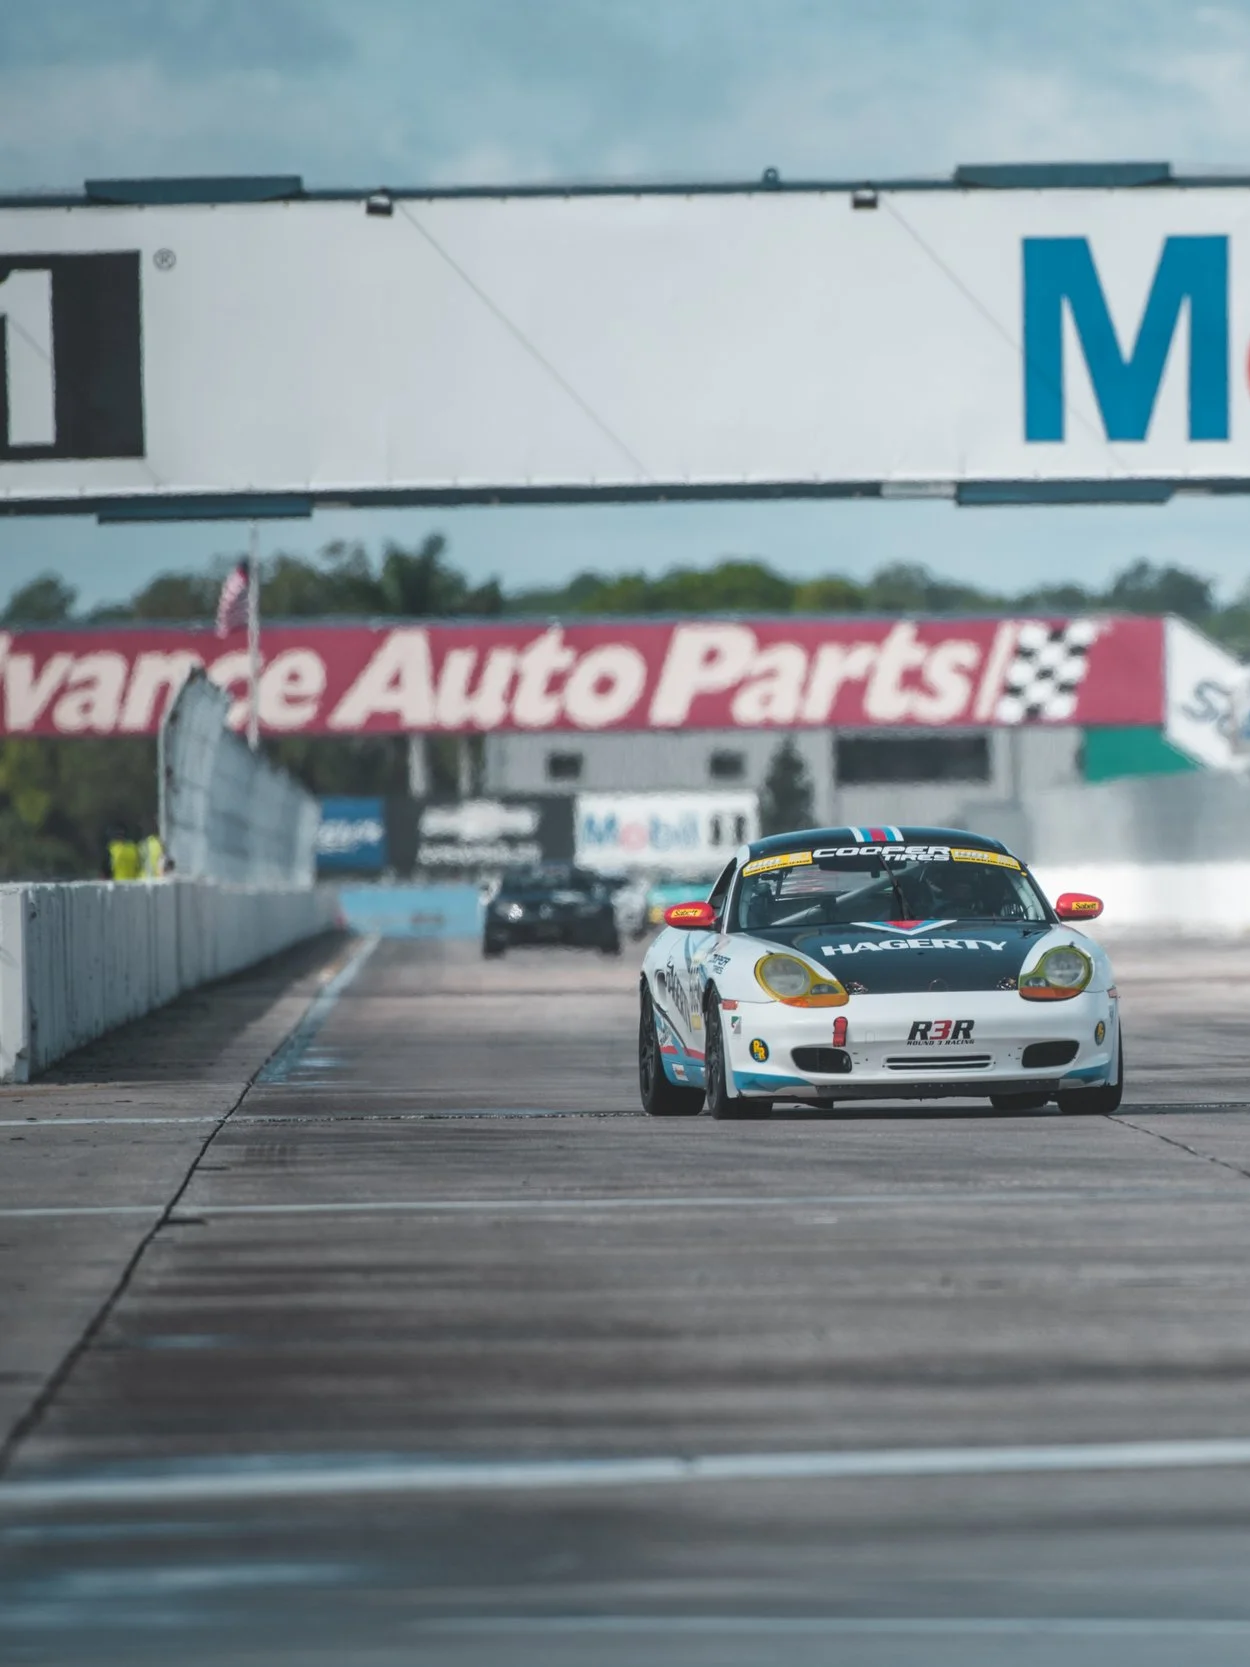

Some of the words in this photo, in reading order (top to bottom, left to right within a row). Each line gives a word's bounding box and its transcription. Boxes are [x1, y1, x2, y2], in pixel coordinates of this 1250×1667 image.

[0, 630, 327, 734] vance
[327, 626, 647, 731] Auto
[649, 622, 980, 727] Parts
[812, 846, 951, 858] COOPER
[821, 938, 1007, 956] HAGERTY
[907, 1019, 975, 1040] R3R
